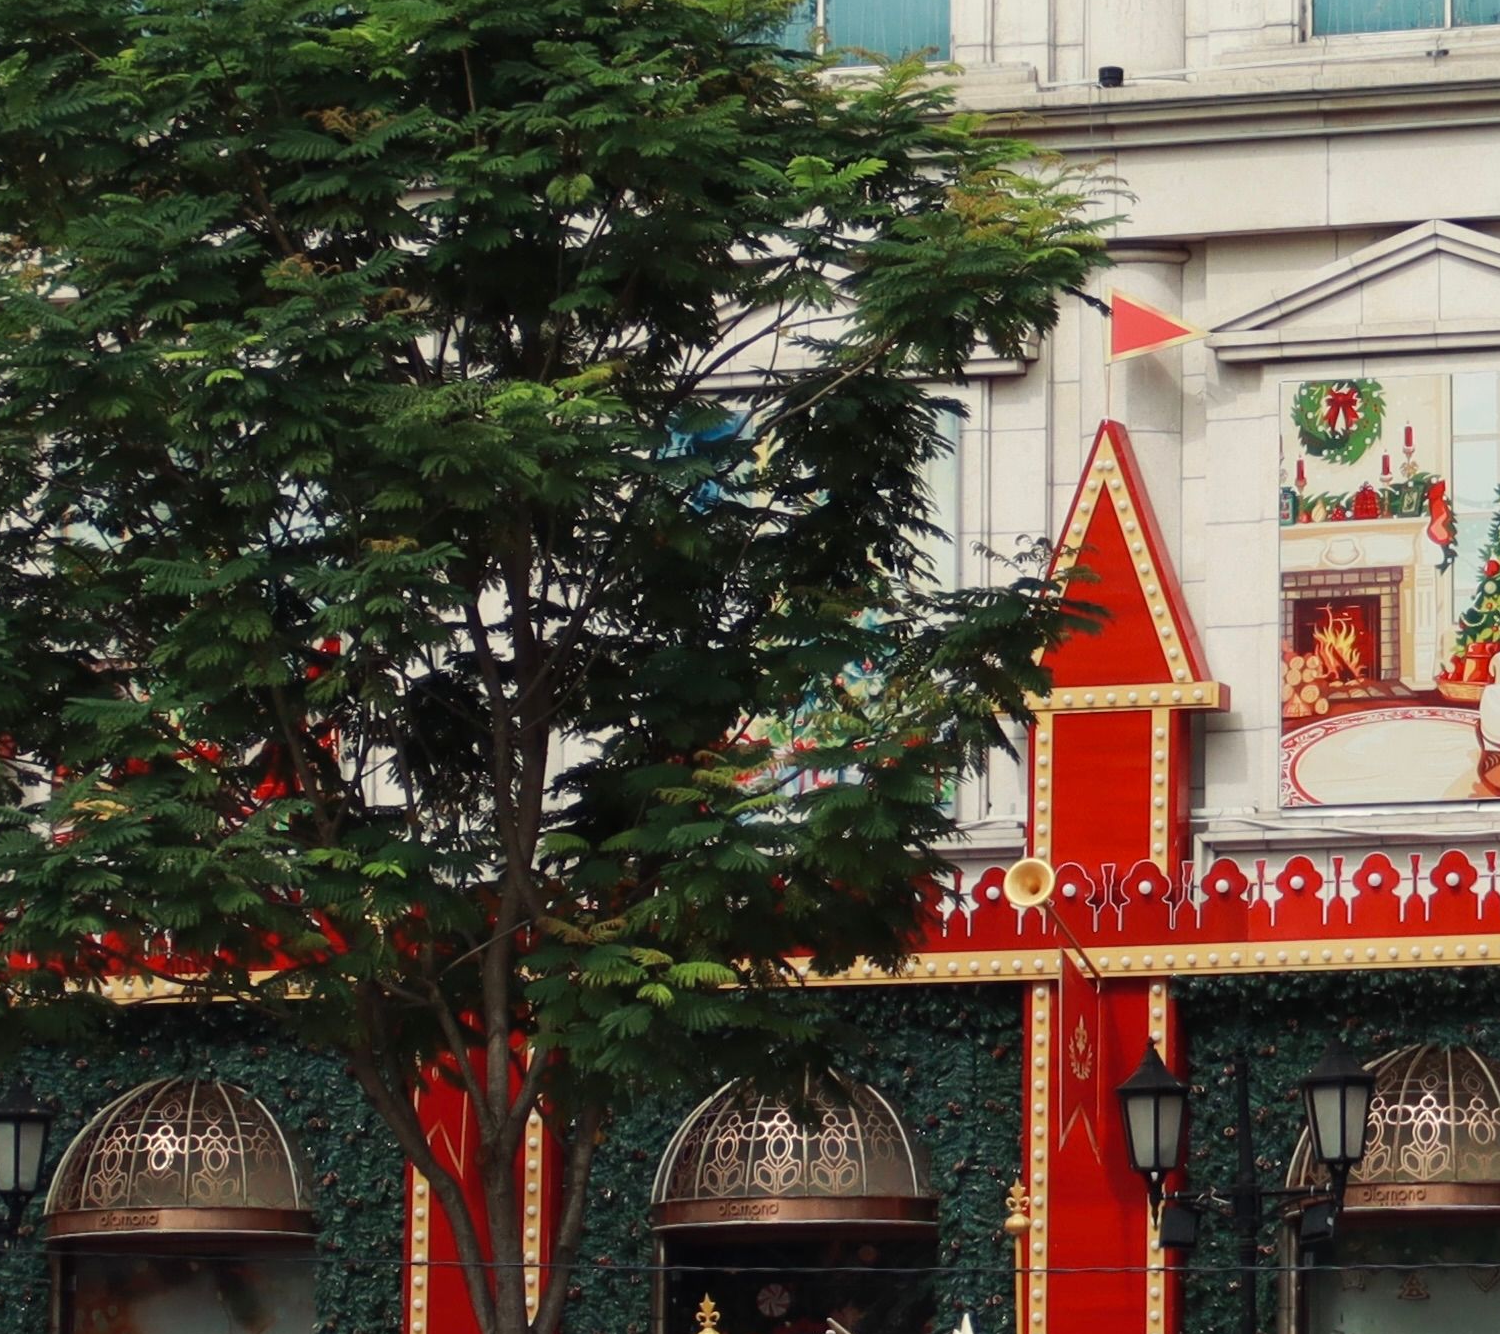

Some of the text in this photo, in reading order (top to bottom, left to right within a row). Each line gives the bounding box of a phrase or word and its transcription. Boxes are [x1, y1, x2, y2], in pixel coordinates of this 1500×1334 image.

[1363, 1186, 1427, 1202] diamond
[718, 1200, 779, 1216] diamond
[100, 1210, 159, 1226] diamond
